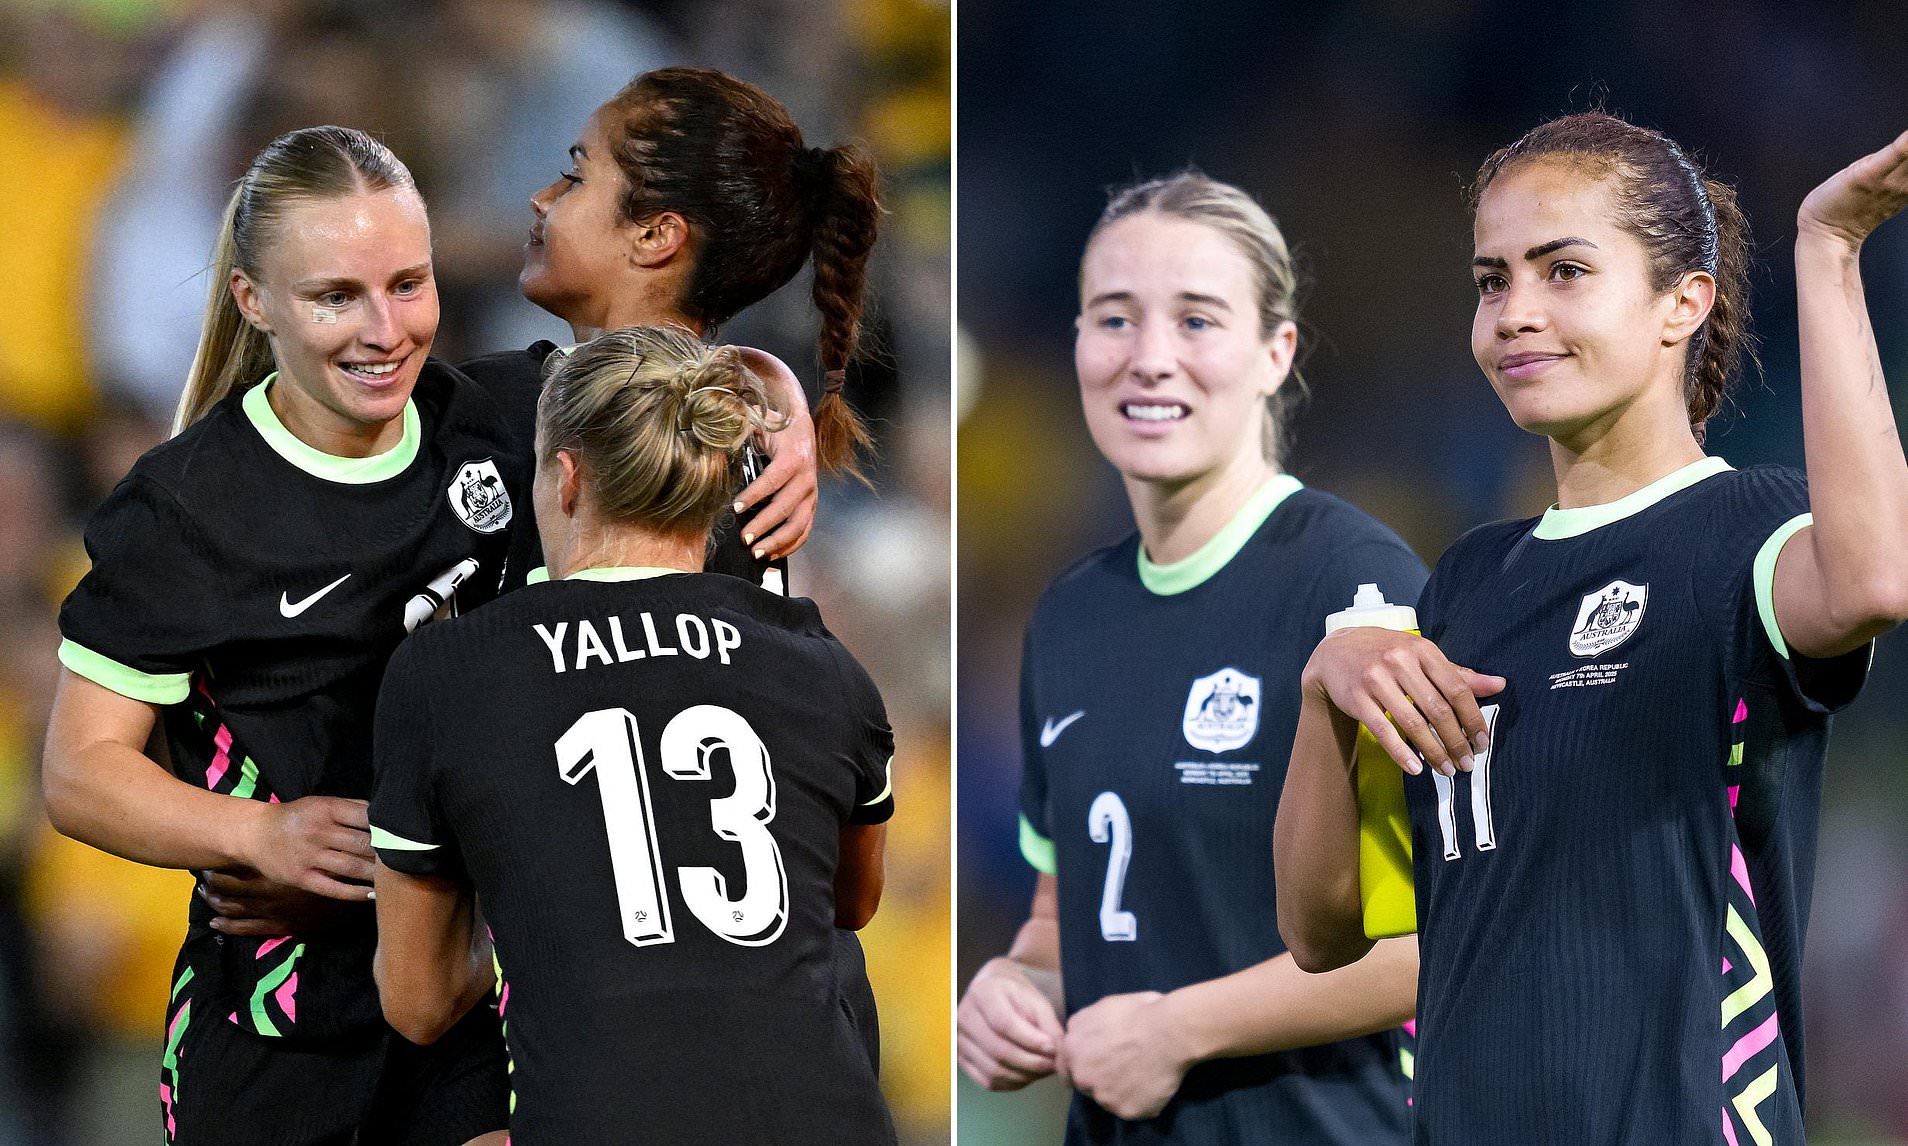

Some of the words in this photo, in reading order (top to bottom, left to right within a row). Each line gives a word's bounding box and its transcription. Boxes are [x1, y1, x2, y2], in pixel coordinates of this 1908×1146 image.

[473, 499, 504, 523] AUSTRALIA
[532, 611, 742, 674] YALLOP
[1579, 625, 1626, 641] AUSTRALIA
[1599, 663, 1629, 671] REPUBLIC
[1585, 677, 1616, 686] AUSTRALIA
[554, 704, 789, 947] 13
[1088, 791, 1137, 941] 2
